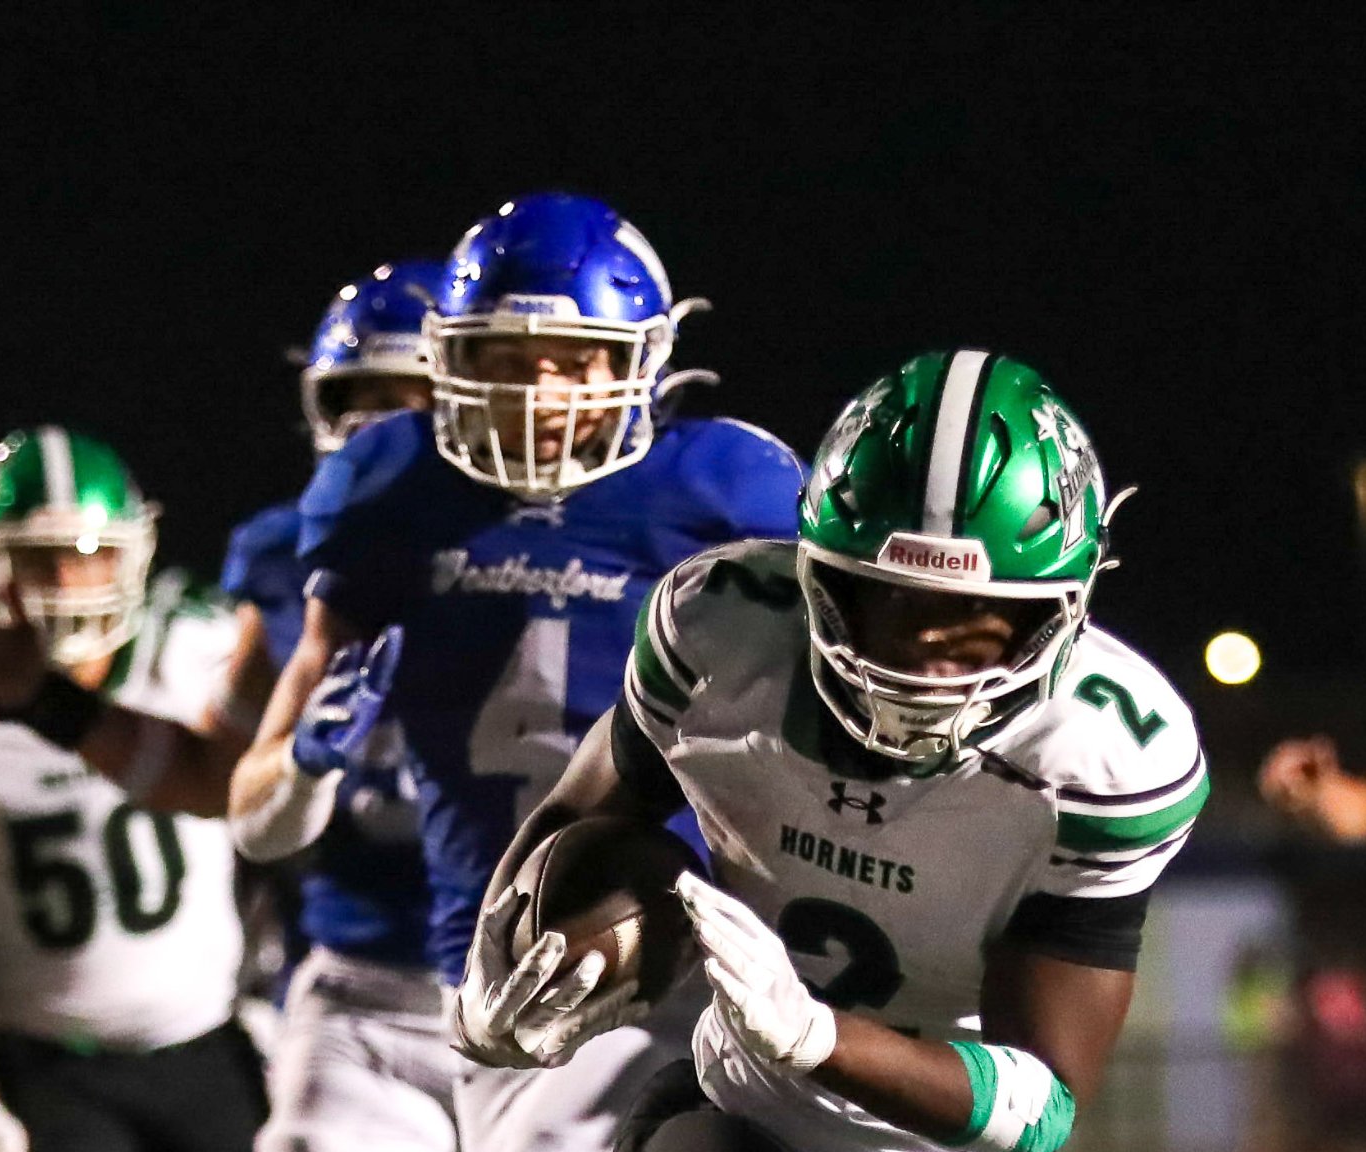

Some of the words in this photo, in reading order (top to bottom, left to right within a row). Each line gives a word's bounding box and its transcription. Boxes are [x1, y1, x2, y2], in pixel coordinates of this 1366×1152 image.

[888, 546, 979, 572] Riddell
[469, 618, 581, 830] 4
[1073, 673, 1168, 751] 2
[7, 799, 184, 949] 50
[780, 824, 917, 894] HORNETS
[777, 897, 915, 1030] 2
